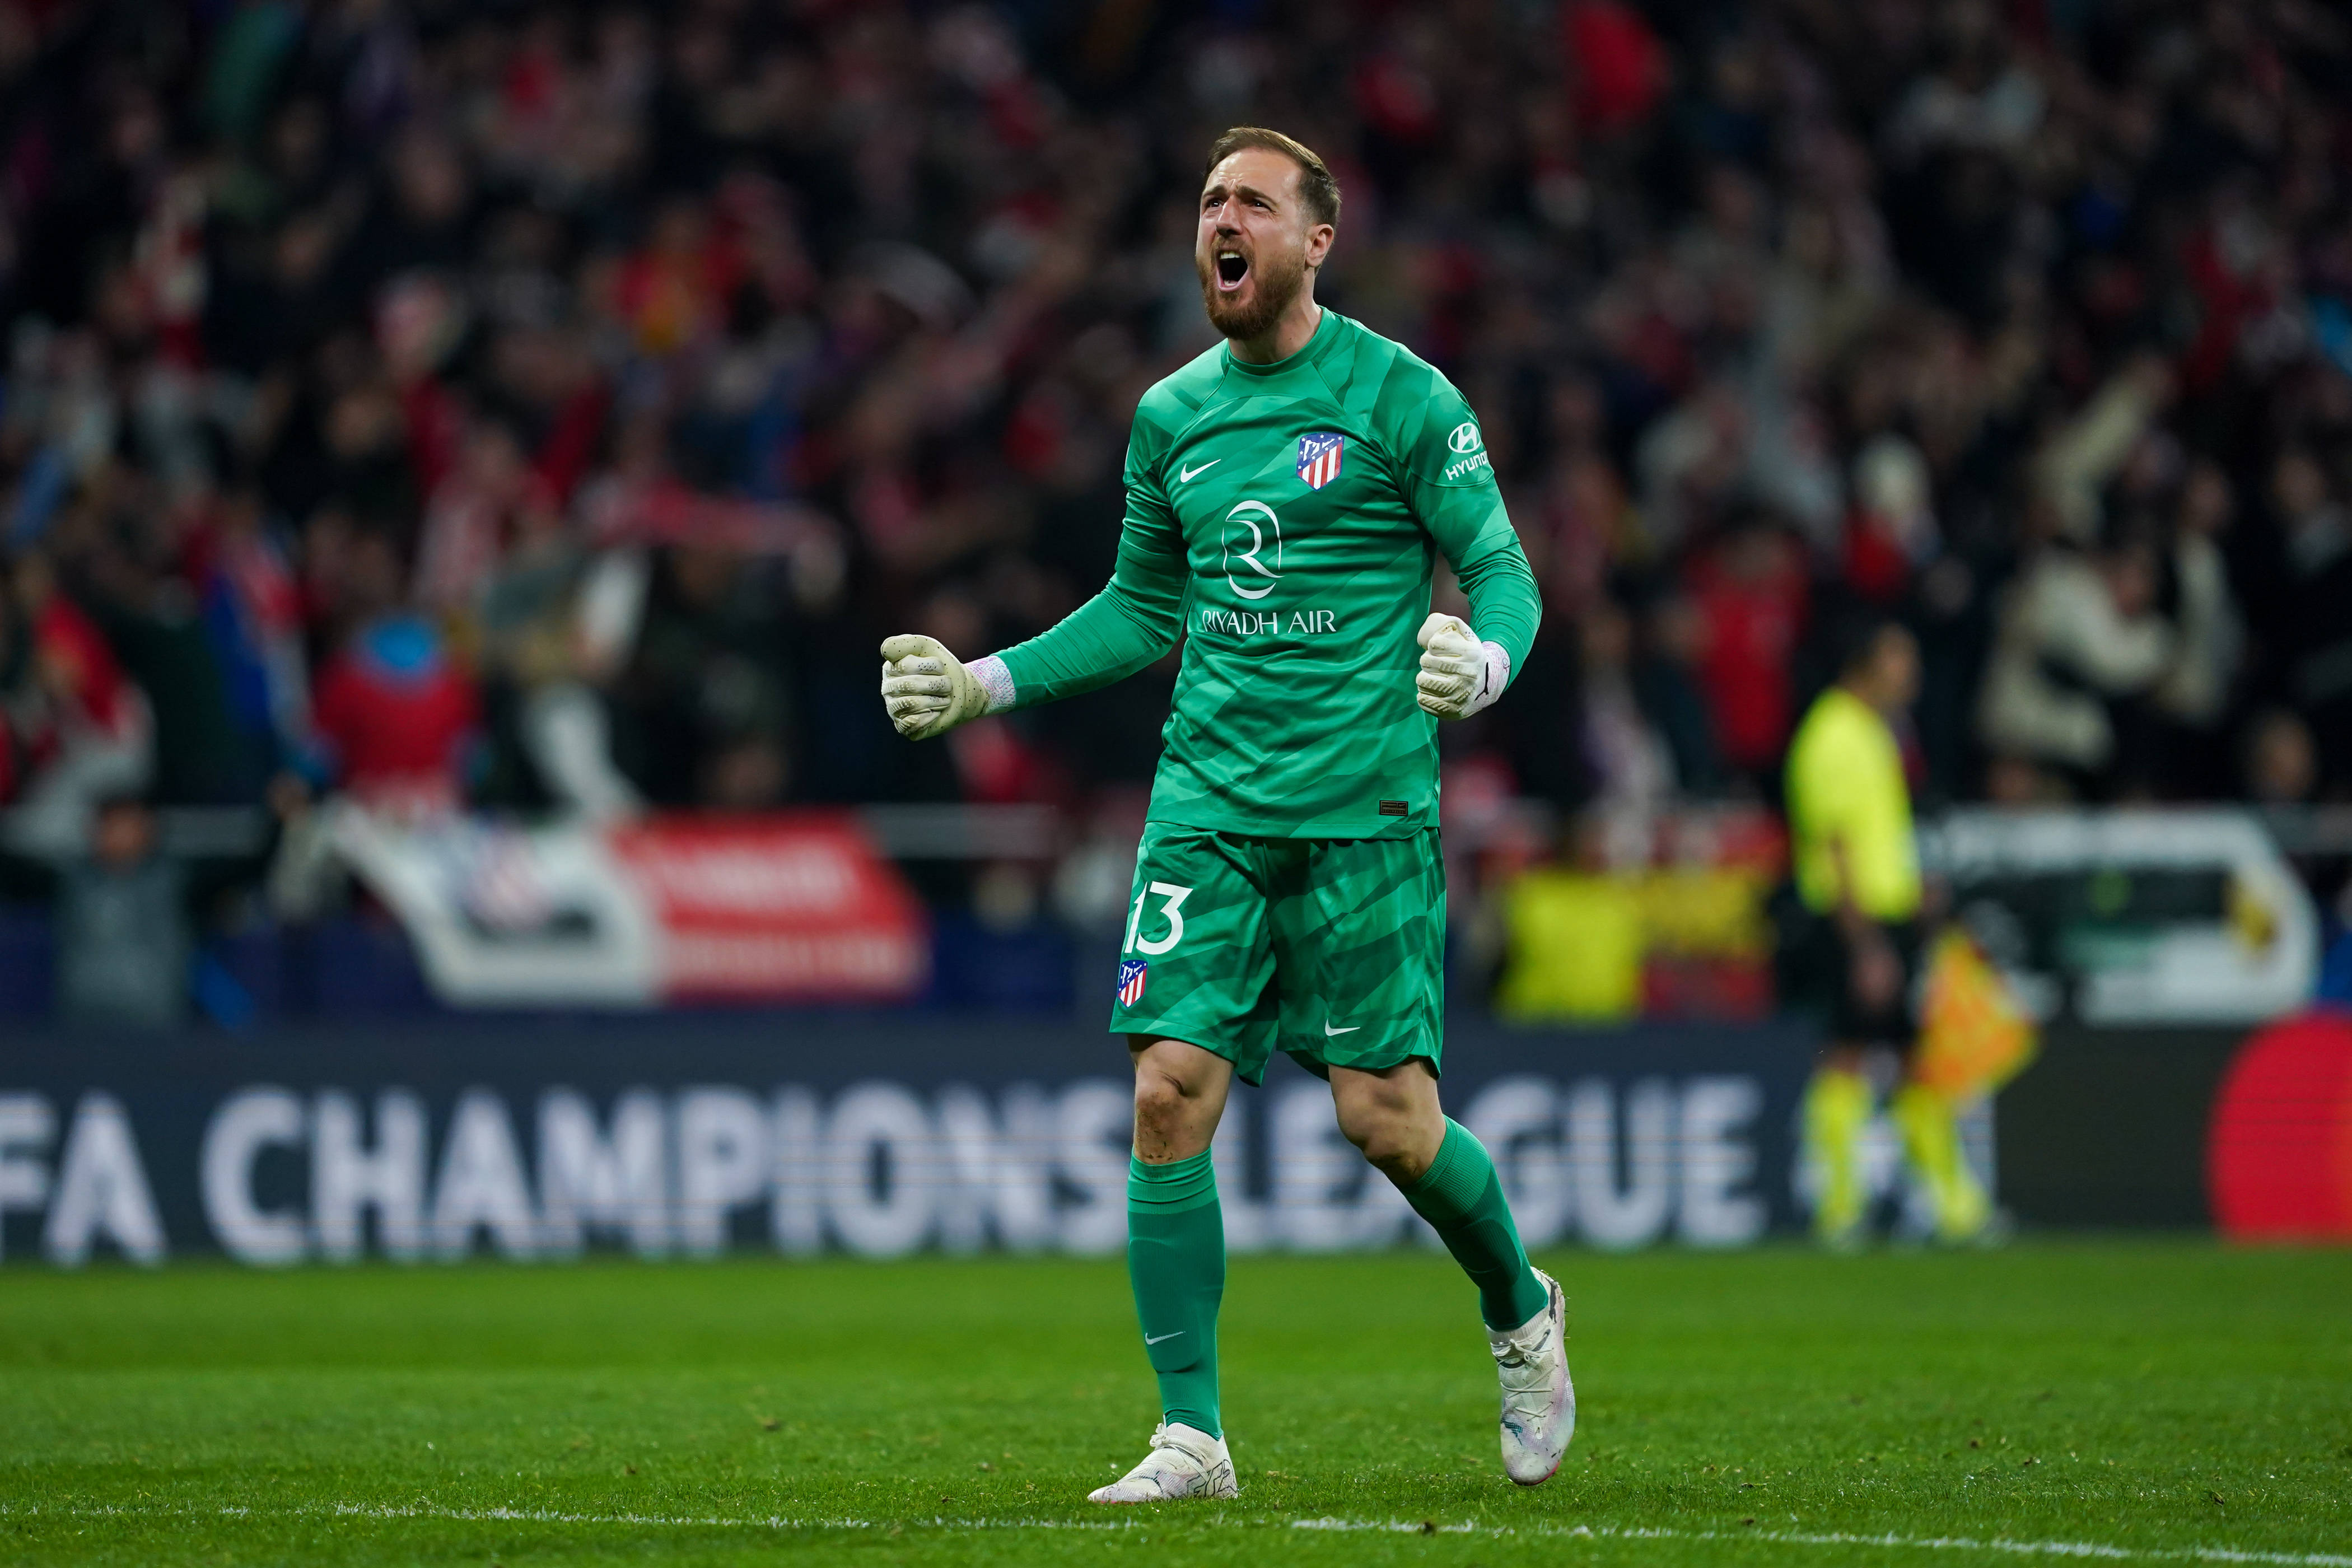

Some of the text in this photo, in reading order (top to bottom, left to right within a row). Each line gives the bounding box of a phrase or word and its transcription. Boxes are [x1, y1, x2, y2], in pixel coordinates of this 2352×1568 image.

[1202, 610, 1336, 634] RIYADH AIR
[1124, 880, 1193, 955] 13
[199, 1081, 1131, 1261] CHAMPIONS
